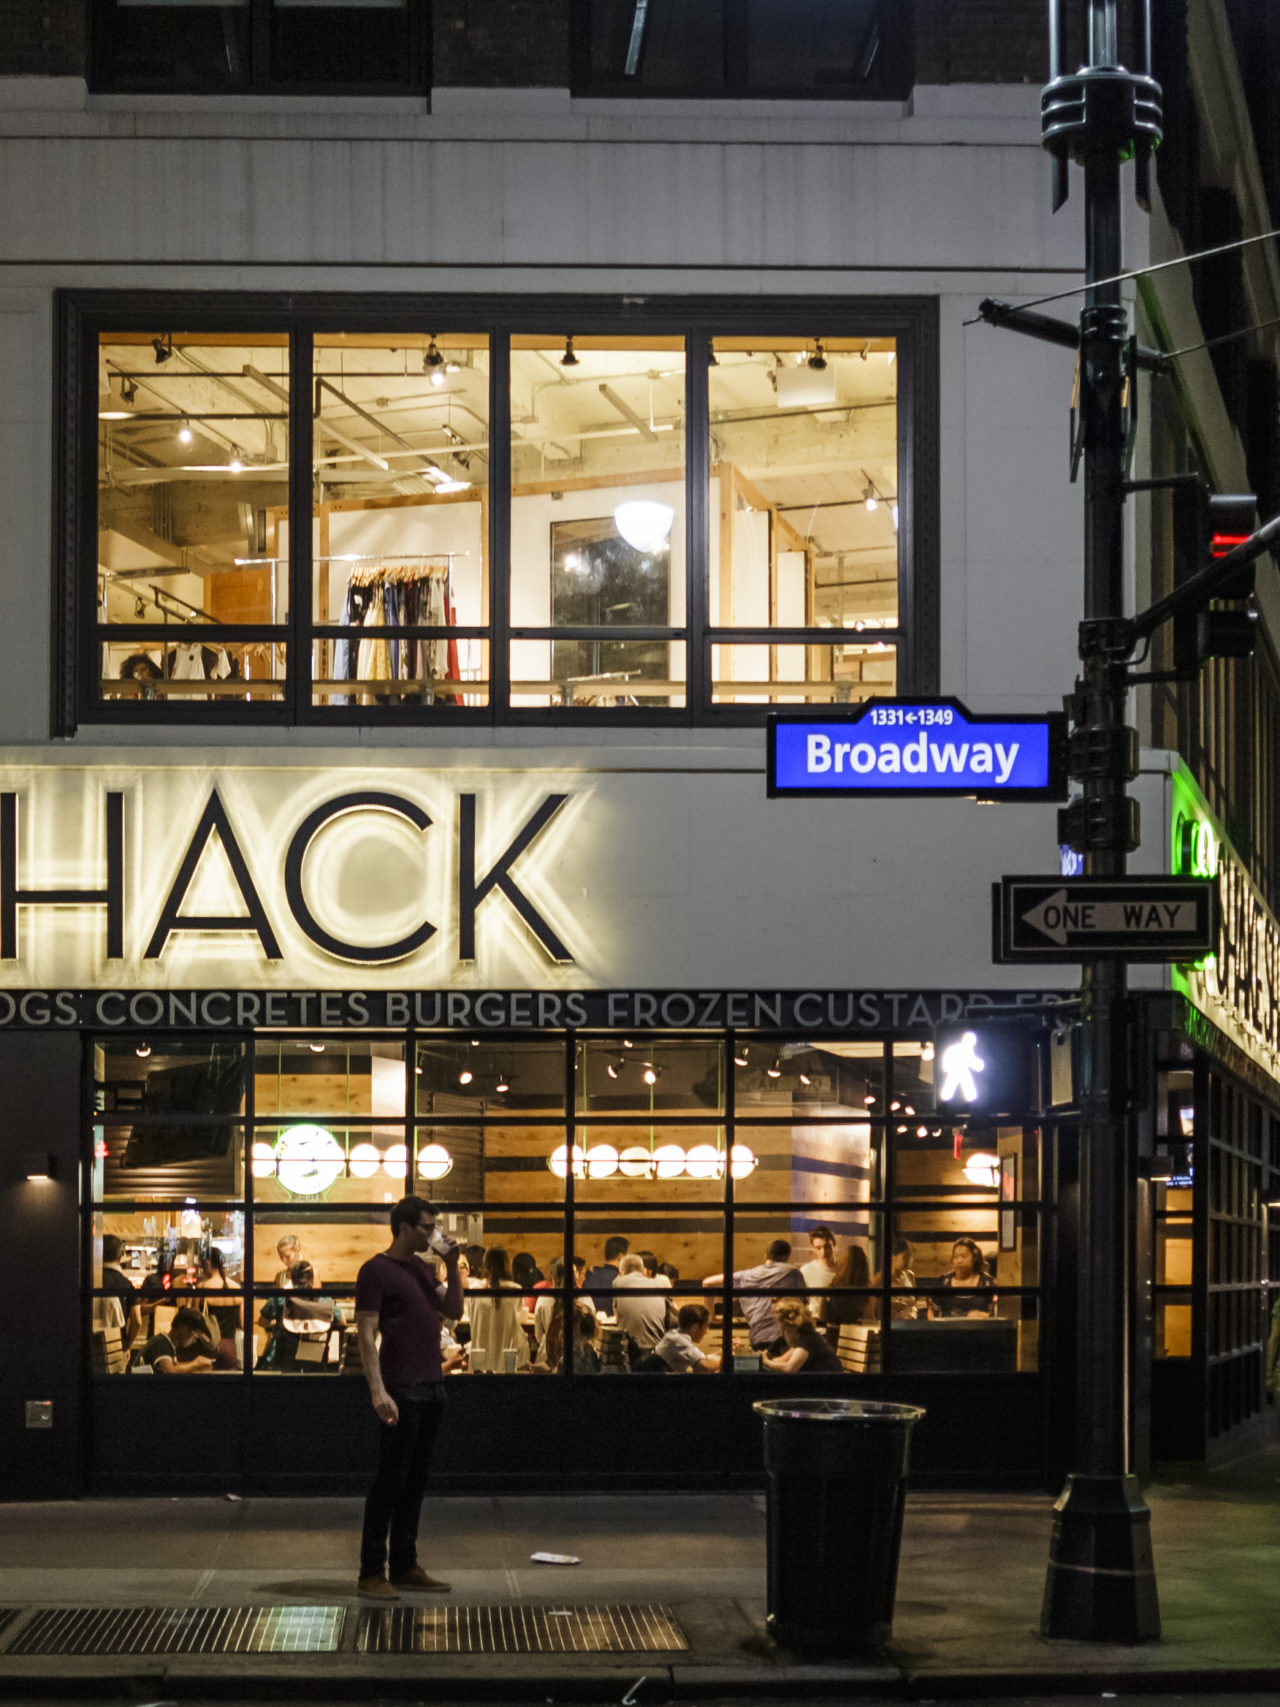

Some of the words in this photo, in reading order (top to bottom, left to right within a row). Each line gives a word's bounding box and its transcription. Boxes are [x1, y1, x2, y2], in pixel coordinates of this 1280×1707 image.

[870, 709, 903, 725] 1331
[917, 709, 953, 726] 1349
[806, 730, 1019, 783] Broadway
[1043, 905, 1096, 929] ONE
[1123, 904, 1182, 928] WAY
[96, 991, 370, 1026] CONCRETES
[386, 992, 587, 1027] BURGERS
[608, 993, 781, 1027] FROZEN
